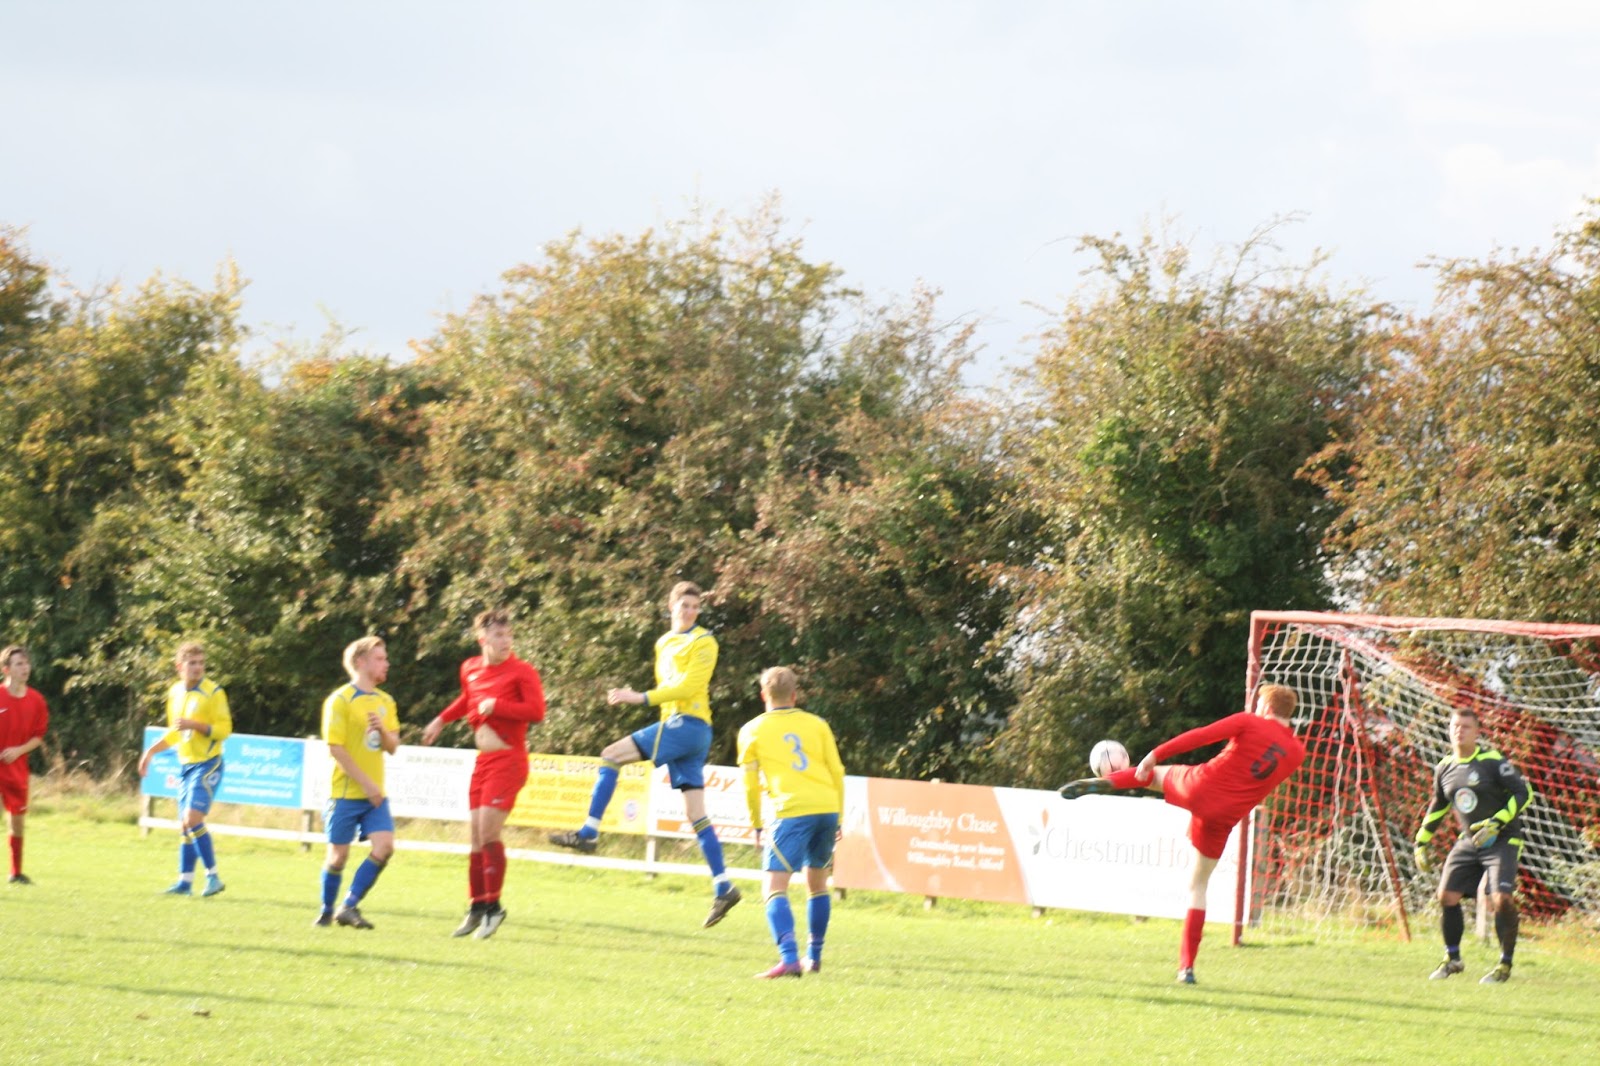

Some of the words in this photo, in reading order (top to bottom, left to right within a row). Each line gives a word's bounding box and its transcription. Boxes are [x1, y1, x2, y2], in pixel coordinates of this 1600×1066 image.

[783, 732, 809, 772] 3
[1250, 742, 1287, 780] 5
[565, 759, 598, 774] SUPP
[624, 763, 646, 777] LTD
[877, 806, 953, 834] Willoughby
[956, 812, 999, 834] Chase
[906, 851, 952, 867] Willoughby
